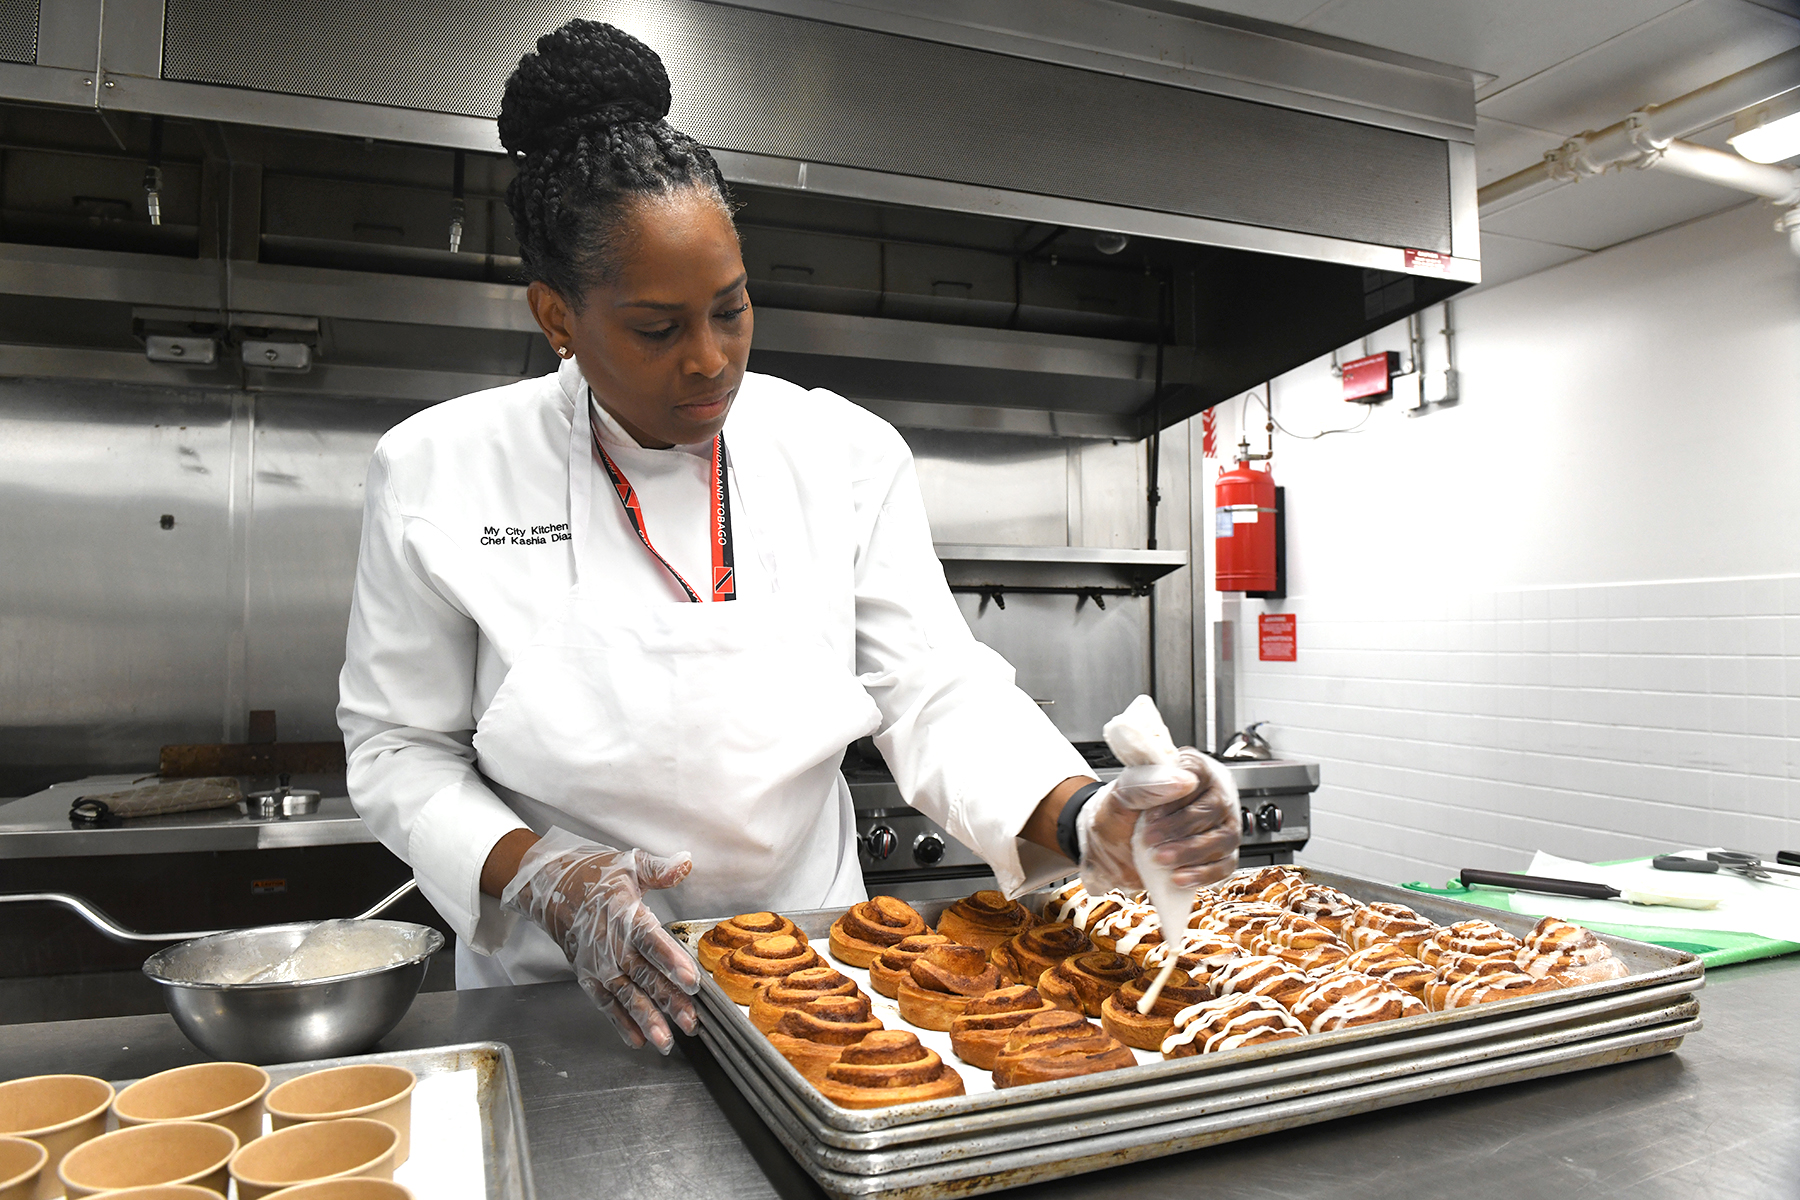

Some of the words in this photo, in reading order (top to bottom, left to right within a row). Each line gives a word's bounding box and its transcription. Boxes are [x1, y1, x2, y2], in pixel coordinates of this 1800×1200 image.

[715, 477, 725, 500] AND
[483, 526, 500, 536] My
[505, 527, 526, 537] City
[531, 523, 569, 535] Kitchen
[716, 502, 727, 546] TOBAGO
[480, 536, 506, 545] Chef
[511, 536, 547, 545] Kashia
[551, 533, 572, 542] Diaz
